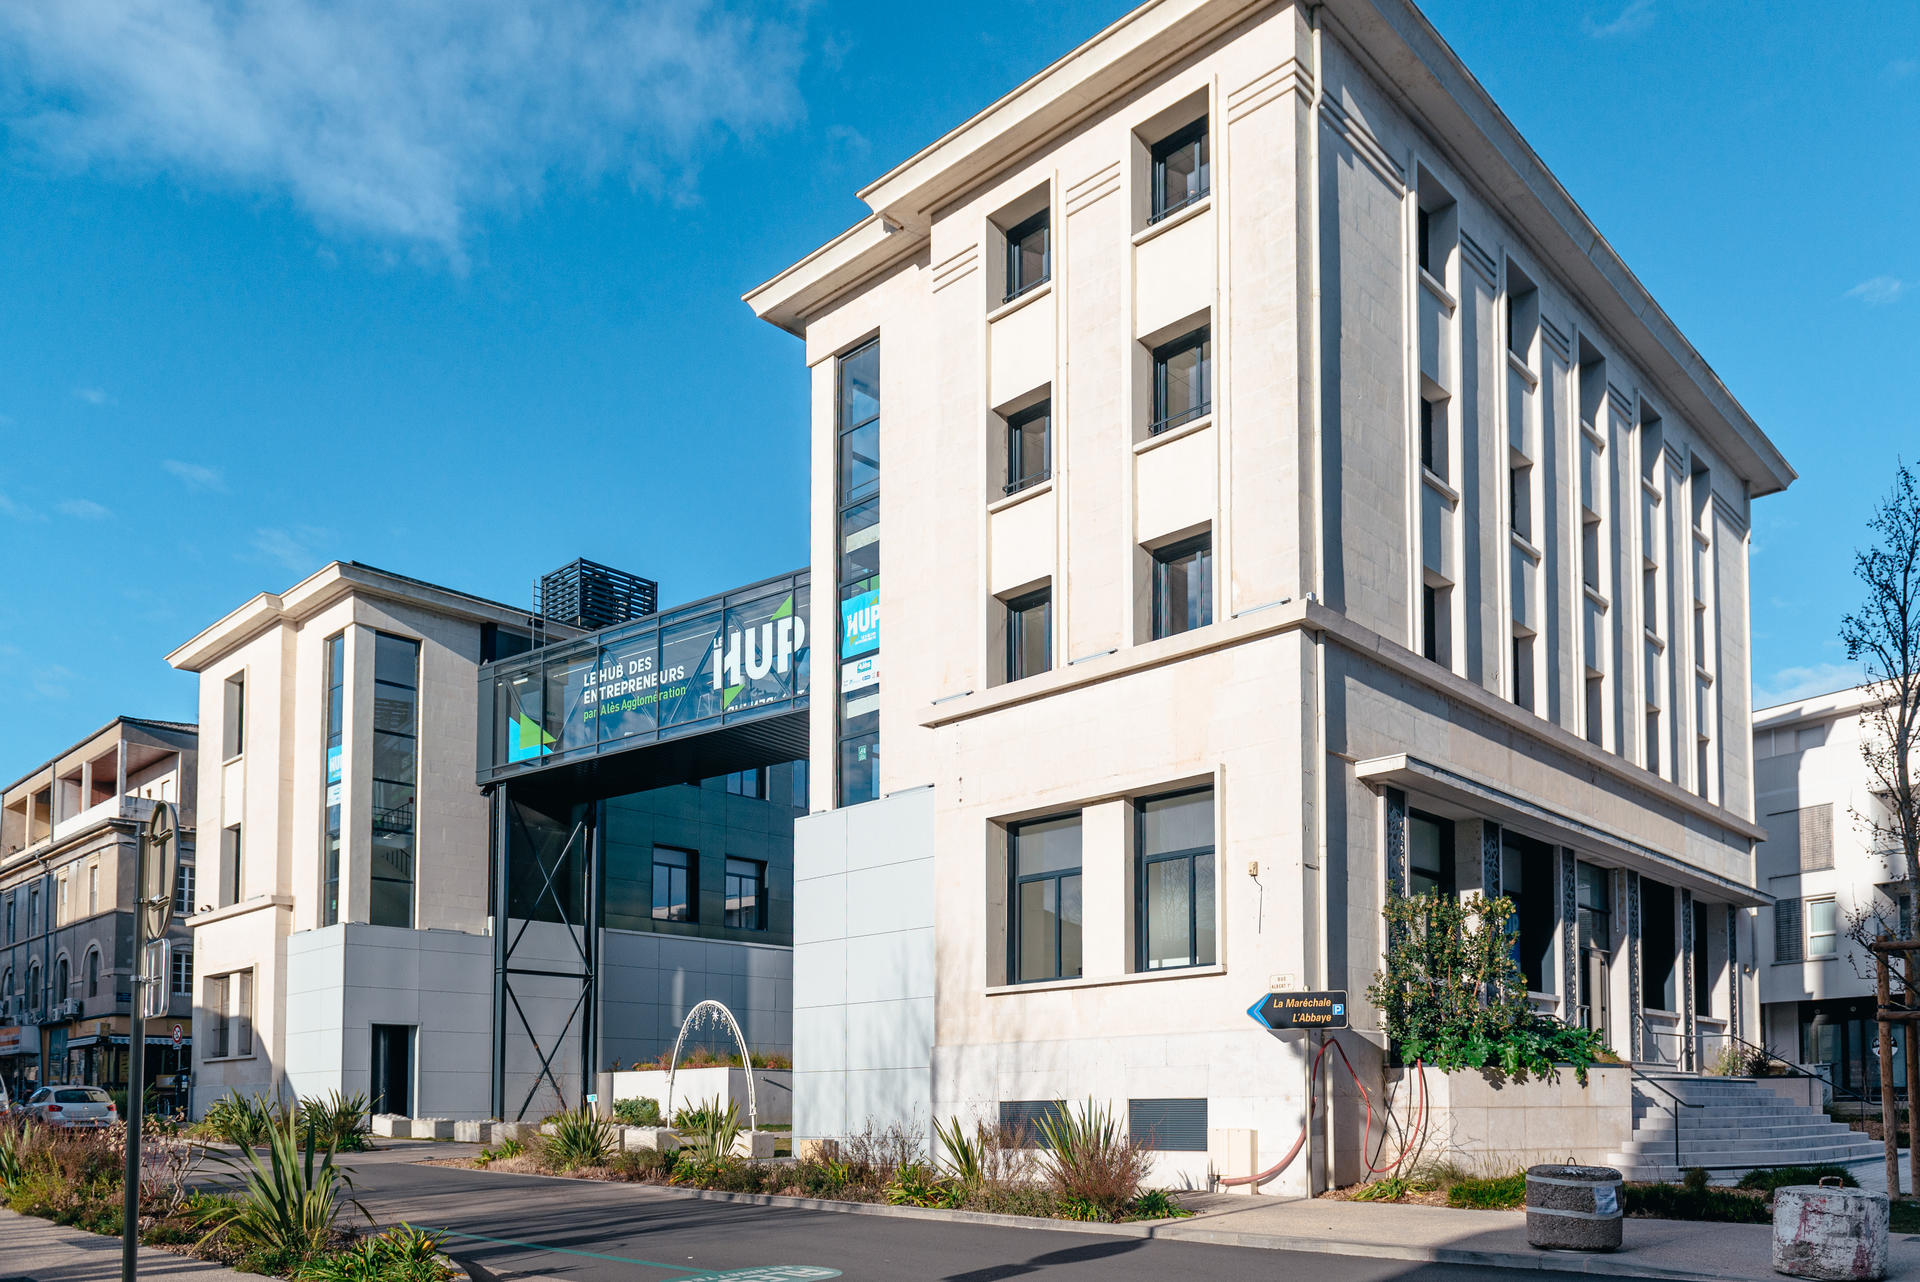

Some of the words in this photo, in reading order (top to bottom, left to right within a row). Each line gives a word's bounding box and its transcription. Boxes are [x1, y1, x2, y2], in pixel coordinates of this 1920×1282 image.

[713, 636, 722, 648] LE
[583, 671, 596, 687] LE
[600, 664, 623, 683] HUB
[629, 656, 652, 675] DES
[583, 665, 685, 705] ENTREPRENEURS
[583, 709, 597, 722] par
[600, 701, 620, 716] Alès
[621, 686, 686, 711] Agglomération
[1273, 999, 1283, 1008] La
[1286, 997, 1331, 1008] Maréchale
[1292, 1013, 1332, 1024] L'Abbaye
